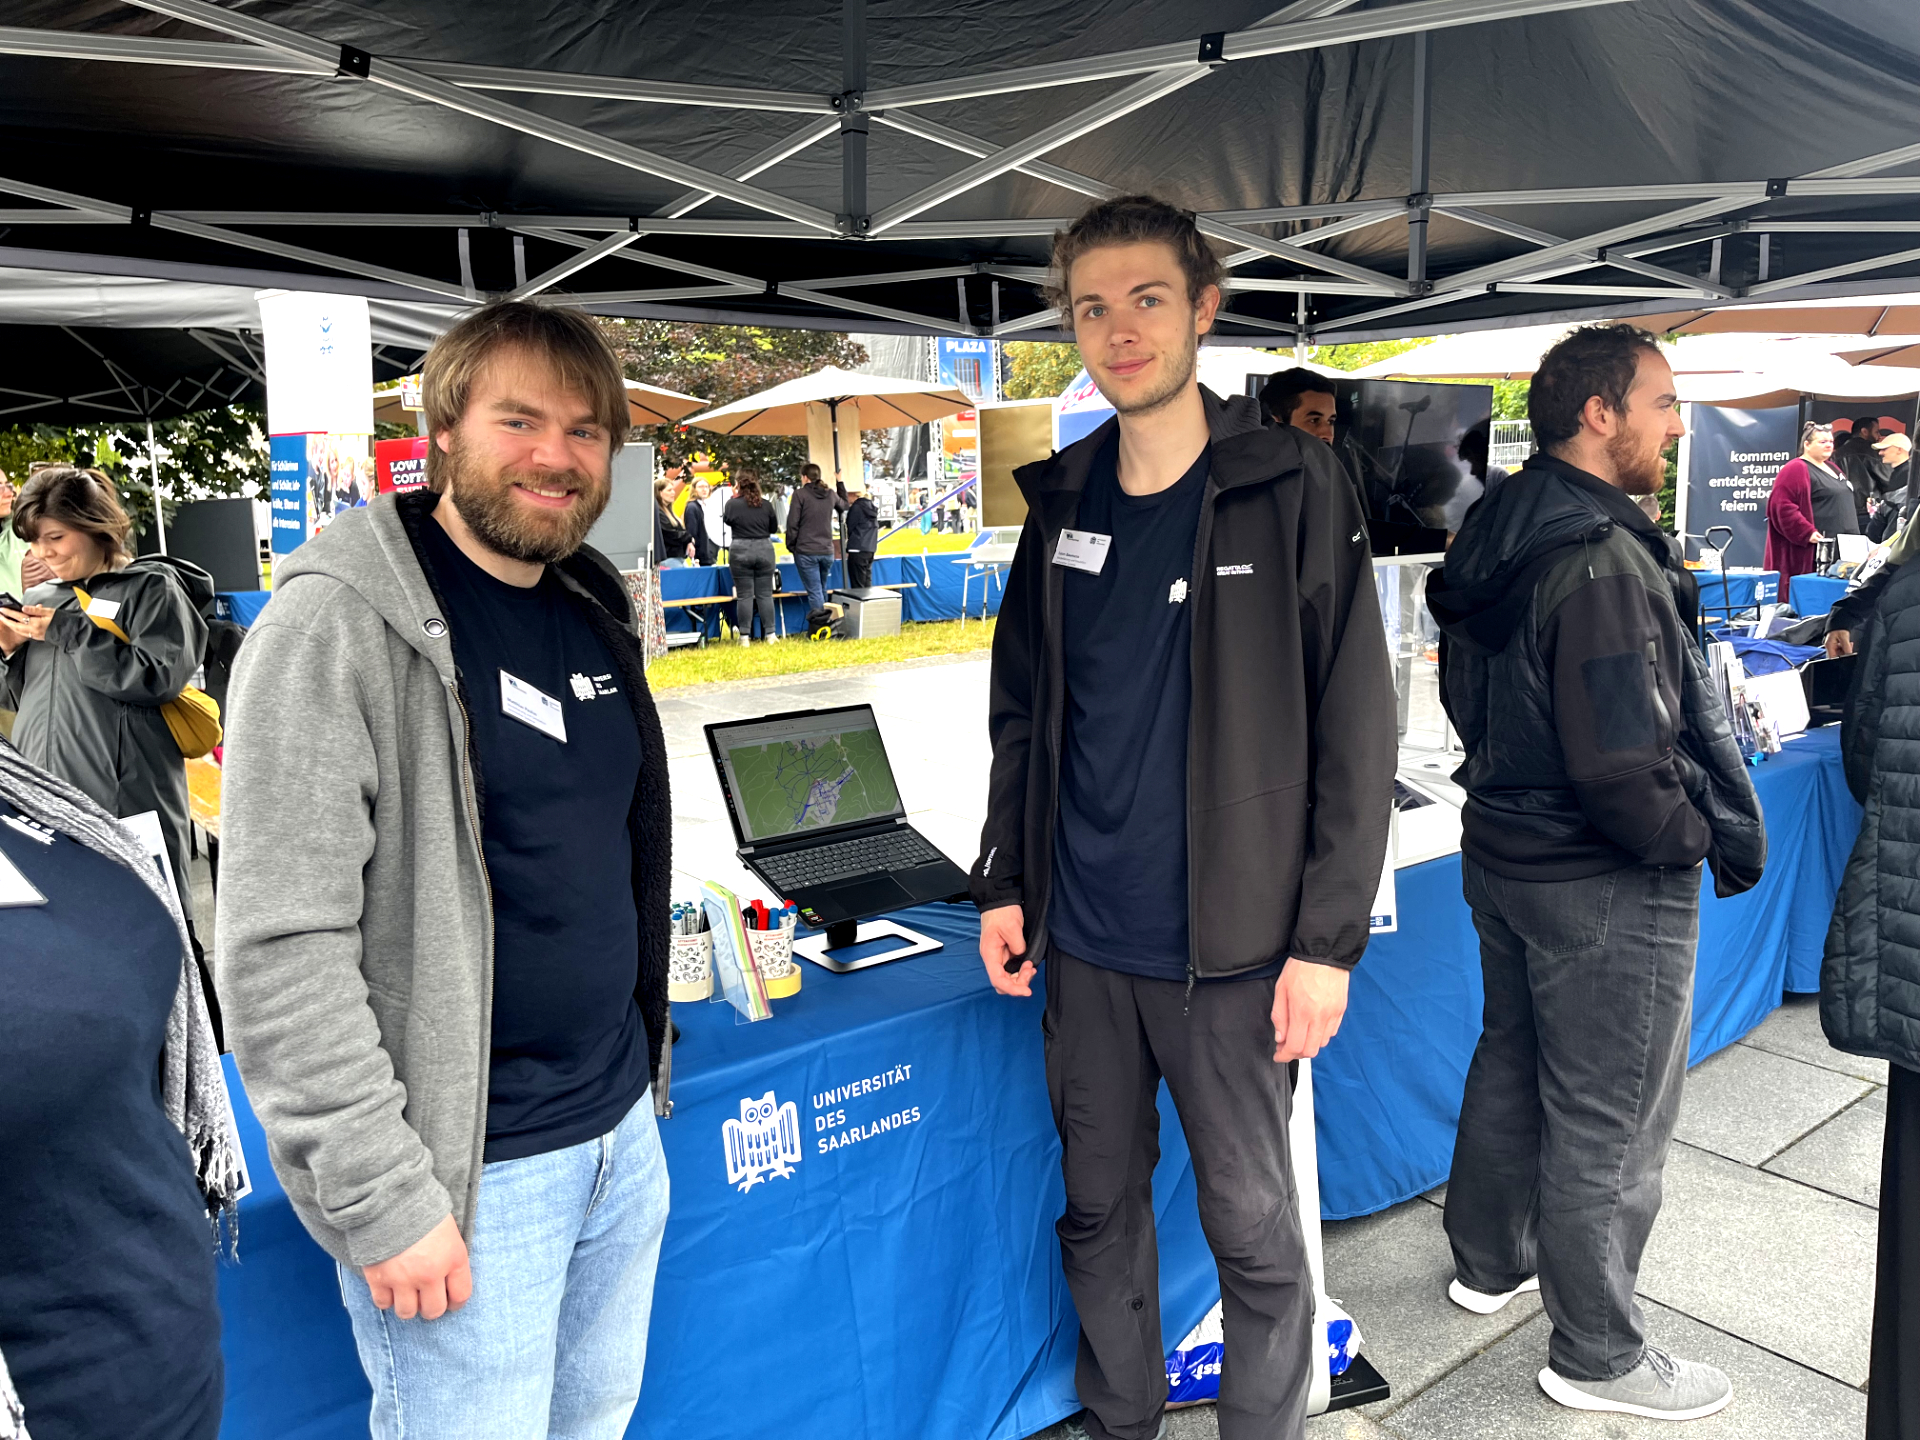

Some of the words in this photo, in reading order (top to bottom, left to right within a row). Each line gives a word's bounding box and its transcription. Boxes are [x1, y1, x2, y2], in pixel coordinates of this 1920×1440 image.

[945, 341, 986, 353] PLAZA
[1730, 450, 1790, 463] kommen
[389, 459, 418, 473] LOW
[392, 472, 427, 485] COFF
[1720, 499, 1758, 512] feiern
[813, 1064, 912, 1110] UNIVERSITÄT
[815, 1109, 846, 1132] DES
[818, 1106, 921, 1154] SAARLANDES
